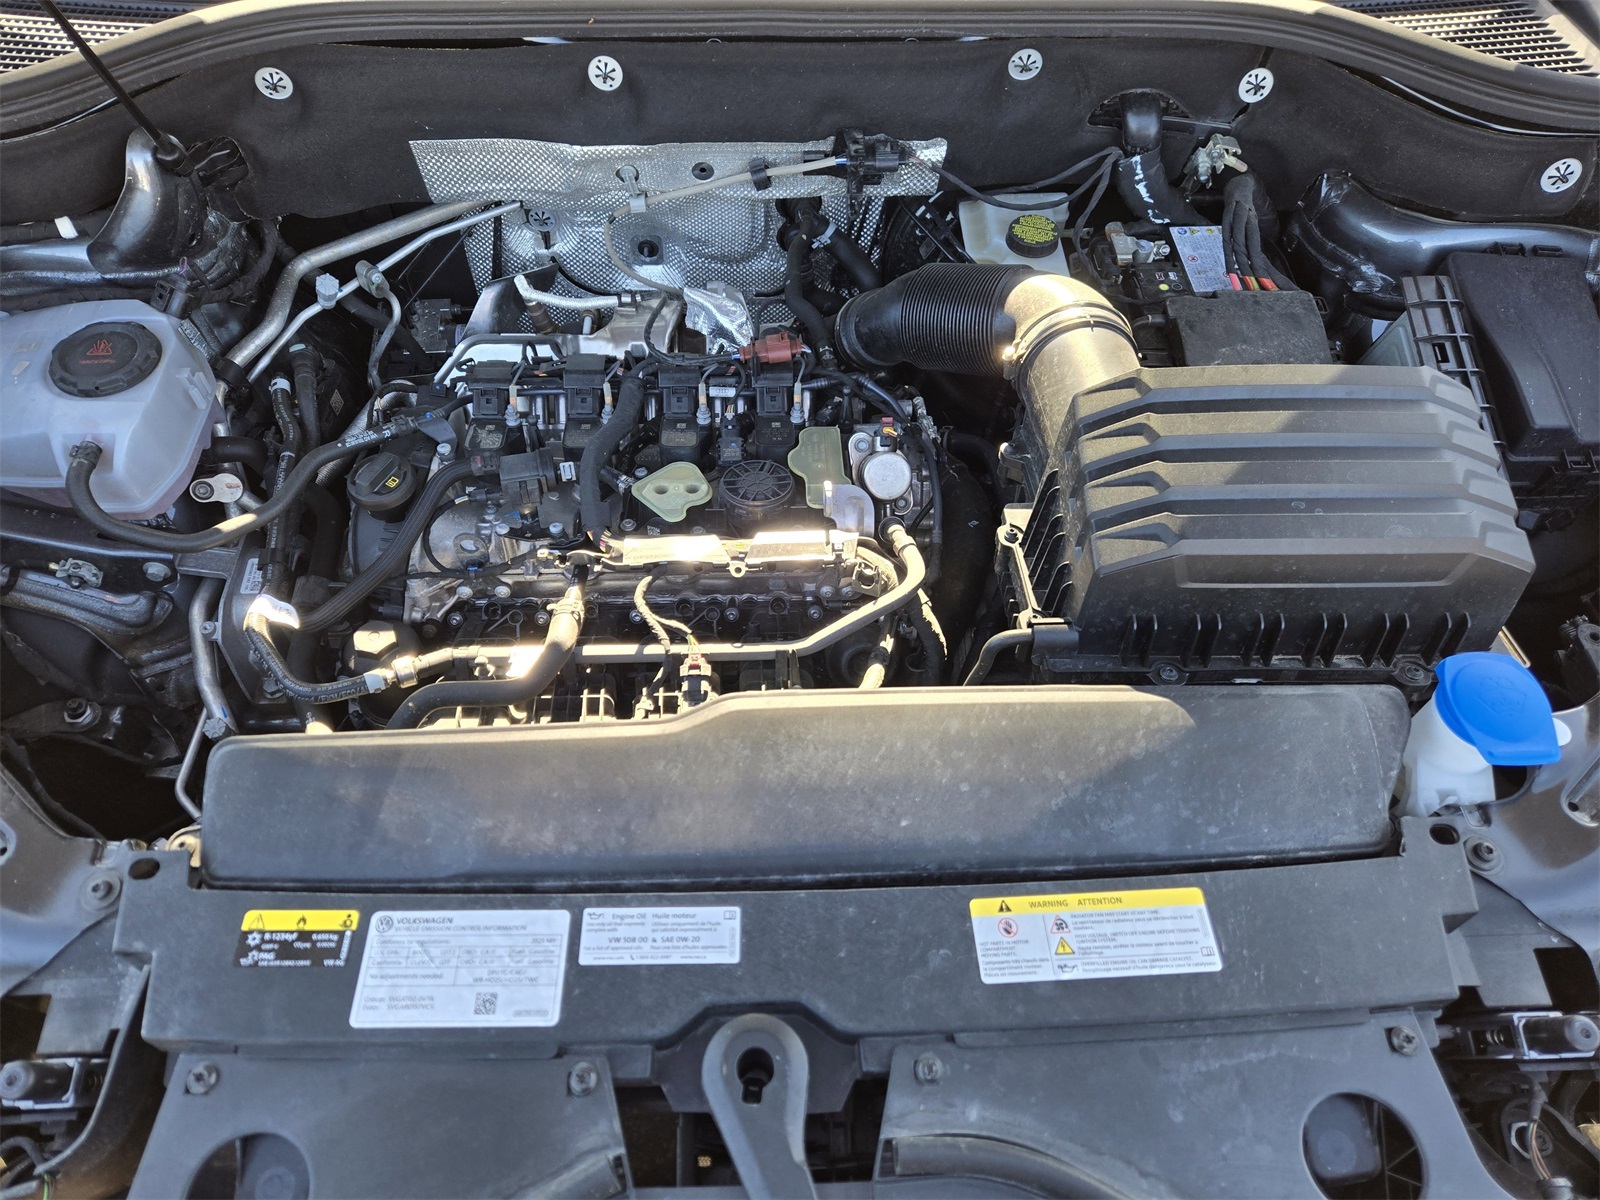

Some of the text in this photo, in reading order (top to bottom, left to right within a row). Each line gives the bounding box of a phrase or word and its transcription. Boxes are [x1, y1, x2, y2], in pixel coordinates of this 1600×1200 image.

[1028, 896, 1123, 908] WARNING ATTENTION
[612, 913, 635, 921] Engine
